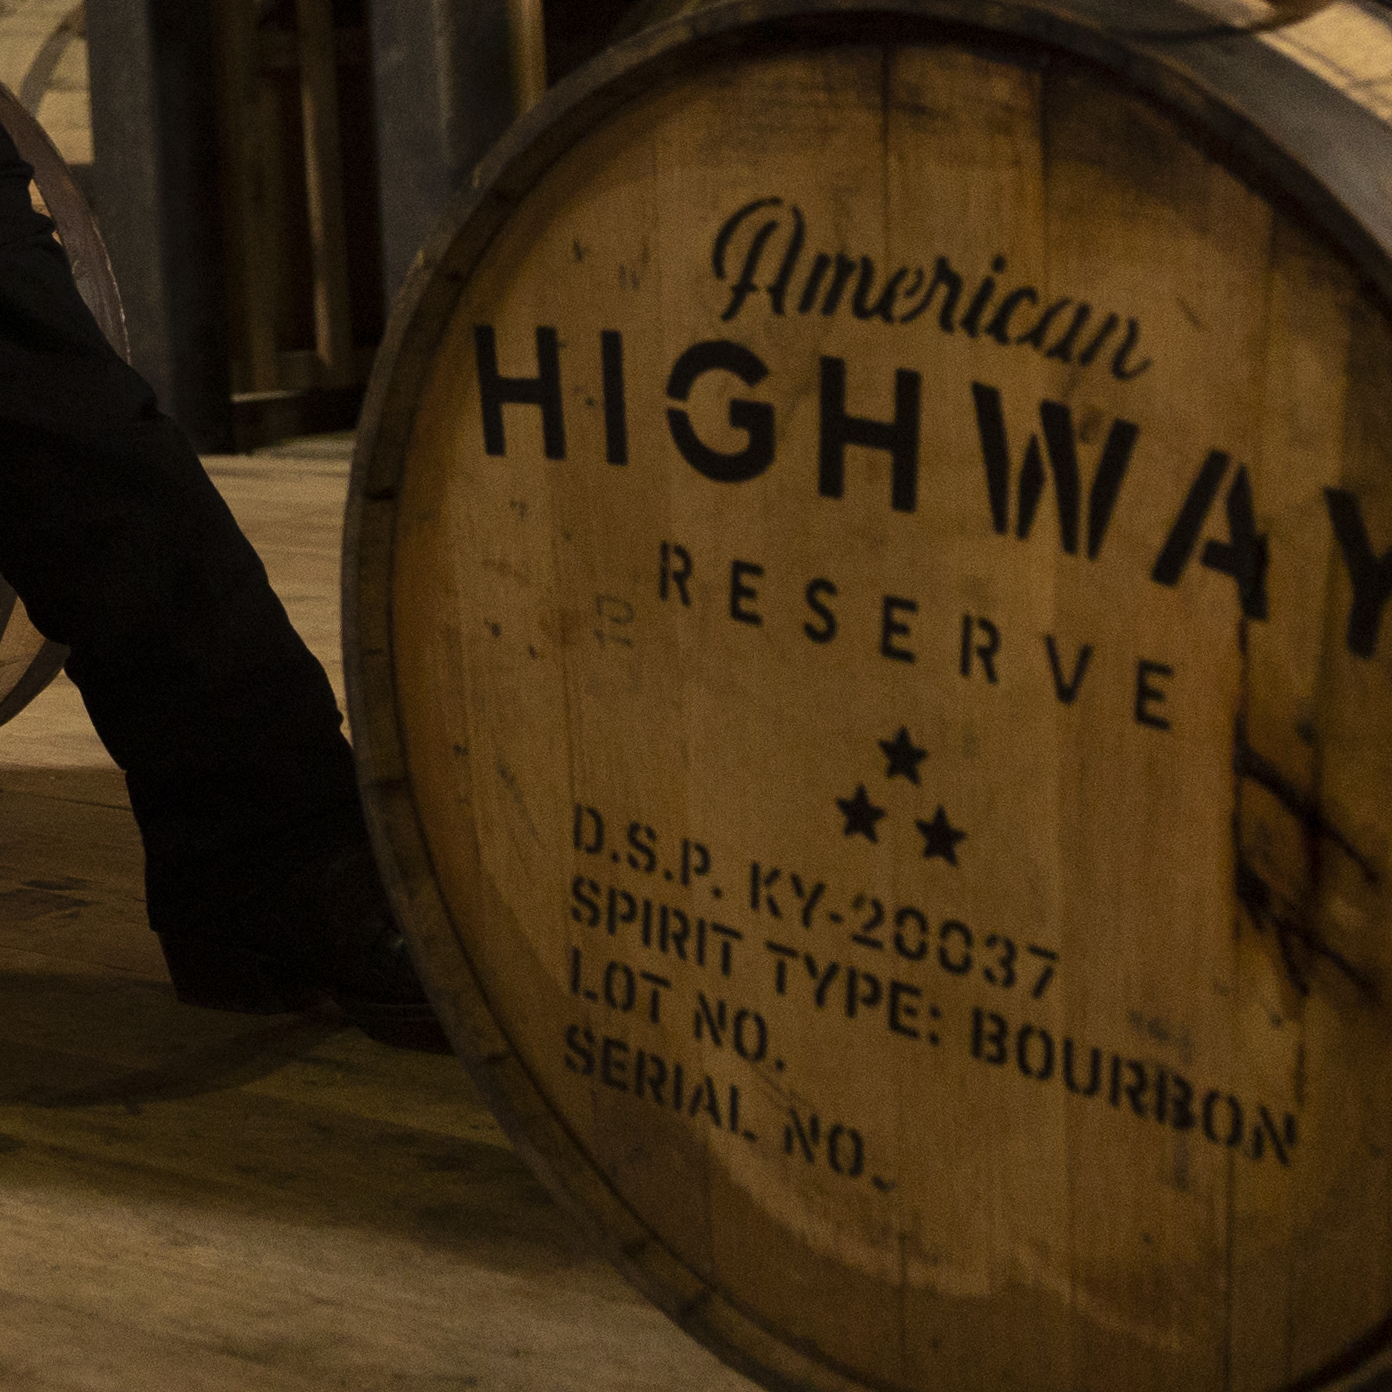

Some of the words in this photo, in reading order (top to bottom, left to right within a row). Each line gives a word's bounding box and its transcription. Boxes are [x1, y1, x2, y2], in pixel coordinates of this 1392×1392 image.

[711, 196, 1153, 381] American
[472, 324, 1392, 662] HIGHWAY
[658, 539, 1176, 732] RESERVE
[571, 803, 723, 900] D.S.P.
[748, 860, 1060, 1001] KY-20037
[568, 945, 673, 1026] LOT
[693, 992, 787, 1074] NO.
[570, 873, 744, 979] SPIRIT
[765, 939, 943, 1048] TYPE:
[969, 1006, 1299, 1170] BOURBON
[563, 1023, 759, 1144] SERIAL
[782, 1107, 894, 1193] NO.
